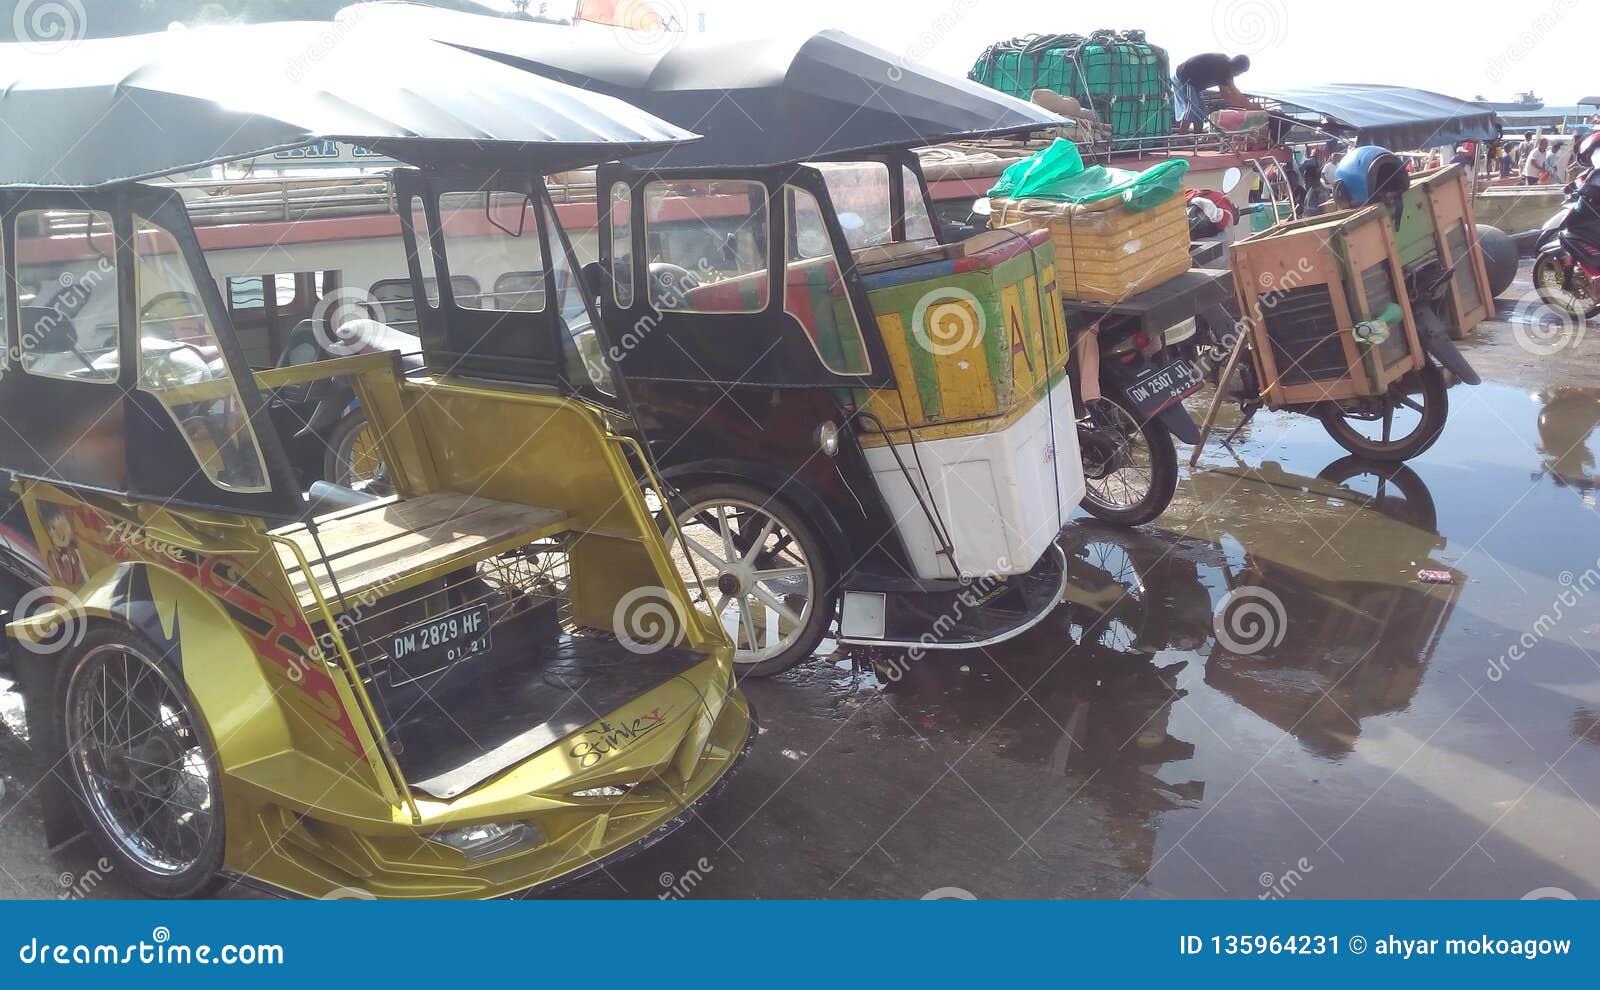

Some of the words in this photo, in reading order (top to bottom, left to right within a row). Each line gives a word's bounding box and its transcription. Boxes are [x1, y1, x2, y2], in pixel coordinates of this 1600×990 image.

[1132, 386, 1150, 402] DM
[1148, 373, 1173, 394] 2507
[394, 633, 415, 659] DM
[420, 619, 458, 649] 2829
[463, 612, 482, 634] HF
